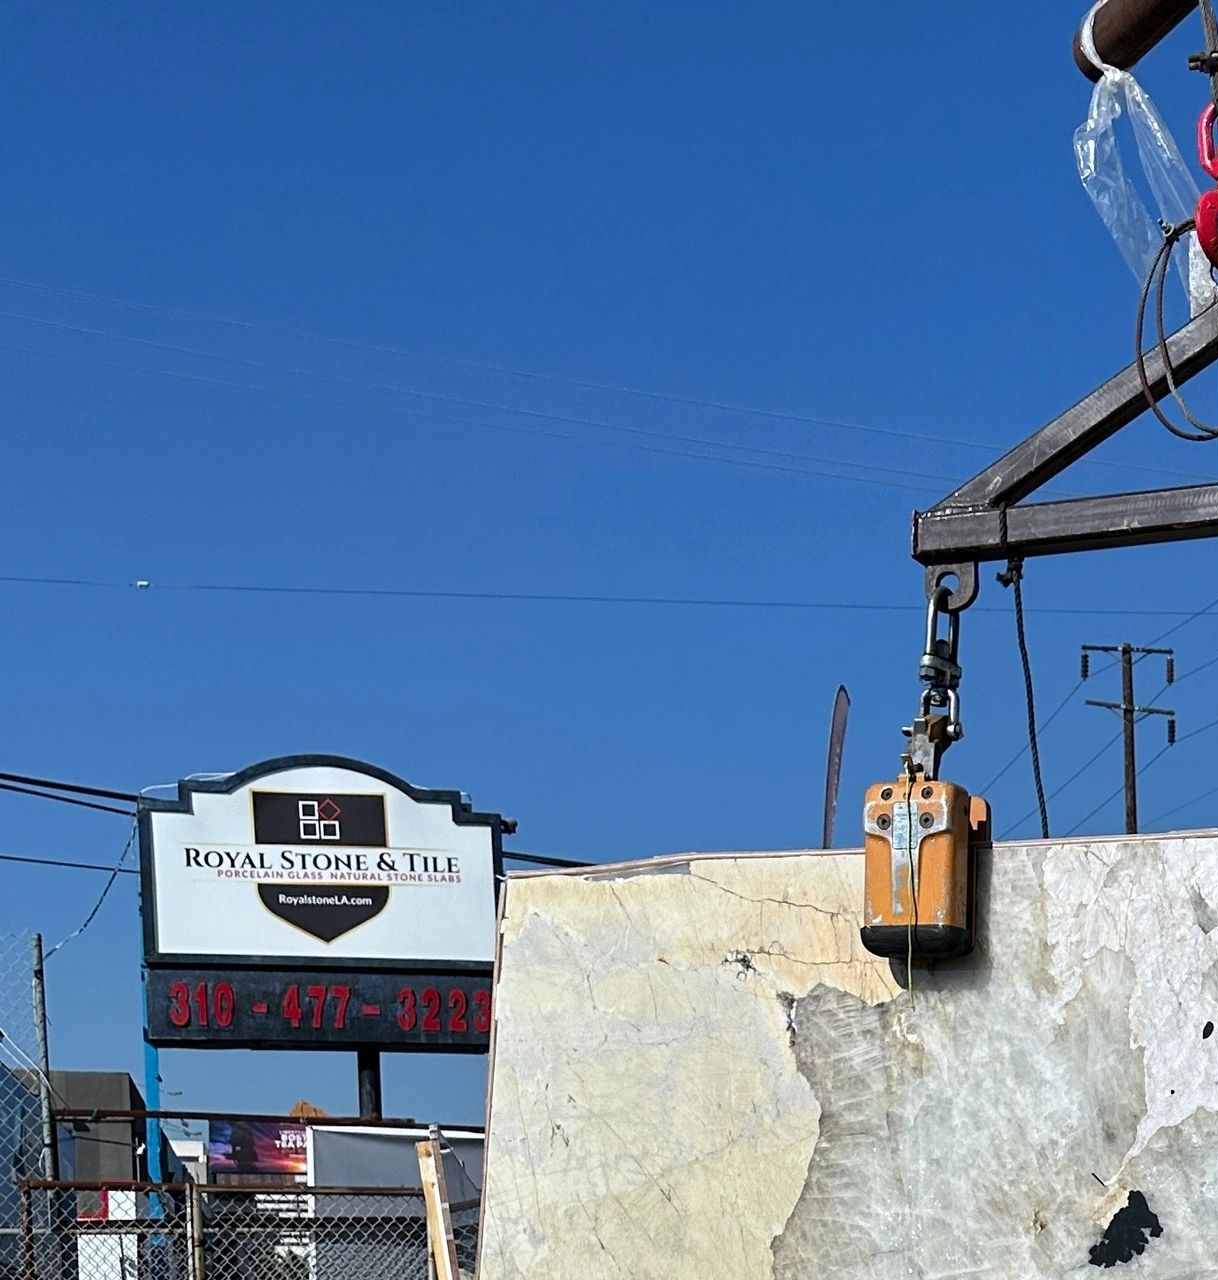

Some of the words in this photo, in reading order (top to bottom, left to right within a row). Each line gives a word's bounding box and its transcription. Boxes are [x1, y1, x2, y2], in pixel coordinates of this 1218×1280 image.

[184, 847, 273, 869] ROYAL
[280, 850, 369, 872] STONE
[376, 852, 398, 872] &
[402, 852, 461, 874] TILE
[217, 869, 284, 879] PORCELAIN
[287, 871, 324, 880] GLASS
[330, 872, 383, 882] NATURAL
[386, 873, 424, 883] STONE
[427, 874, 462, 884] SLABS
[278, 893, 373, 906] RoyalstoneLA.com
[168, 981, 235, 1028] 310
[282, 984, 351, 1030] 477
[396, 986, 490, 1033] 3223
